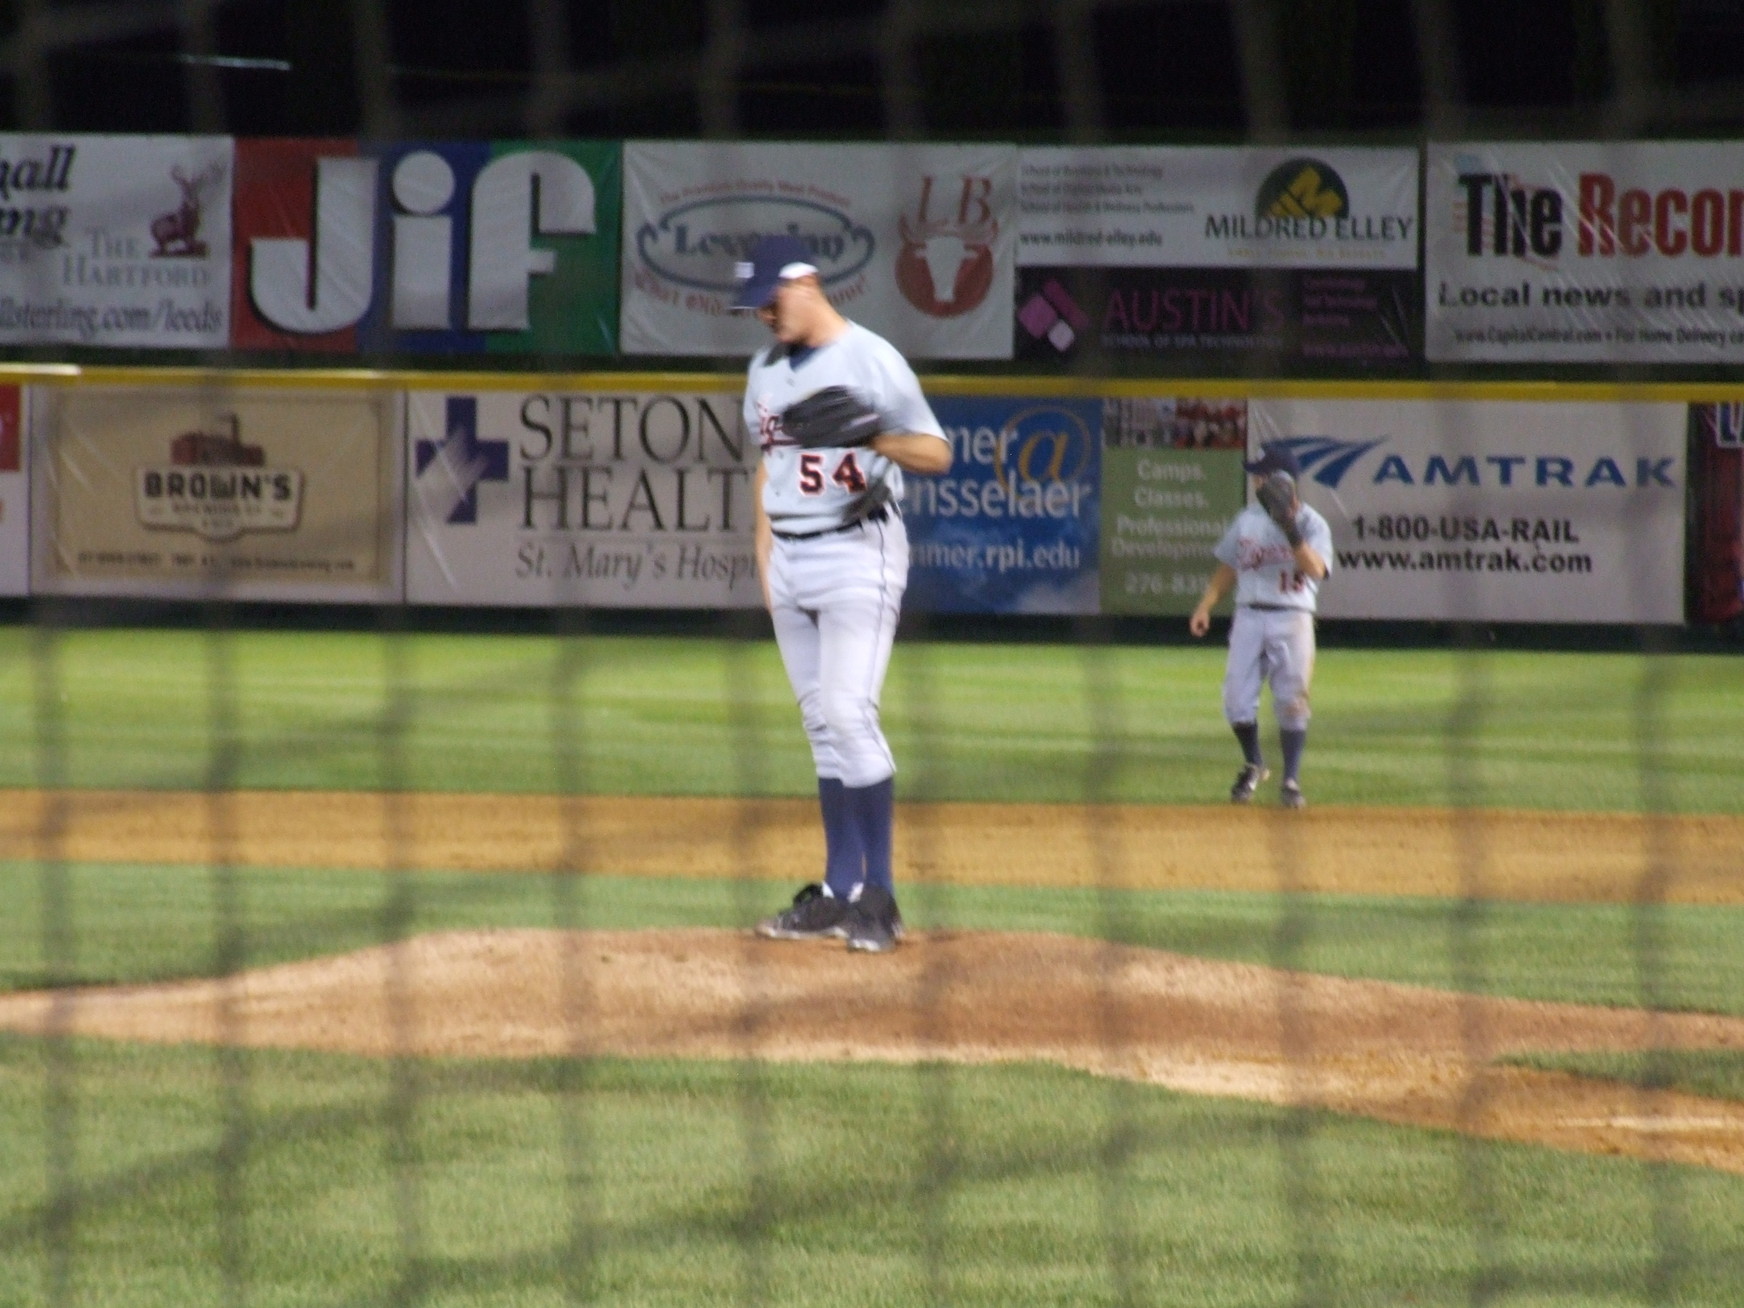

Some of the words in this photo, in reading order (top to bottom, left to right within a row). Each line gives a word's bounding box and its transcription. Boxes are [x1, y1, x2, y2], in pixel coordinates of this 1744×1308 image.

[1205, 213, 1327, 241] MILDRED
[1335, 215, 1414, 241] ELLEY
[1458, 172, 1563, 256] The
[251, 151, 596, 333] Jif
[1439, 281, 1531, 308] Local
[1543, 285, 1631, 308] news
[1646, 282, 1706, 308] and
[520, 394, 747, 463] SETON
[144, 471, 291, 501] BROWN'S
[798, 451, 867, 497] 54
[1373, 454, 1677, 488] AMTRAK
[521, 466, 757, 532] HEALT
[903, 470, 1092, 519] nsselaer
[1351, 514, 1580, 544] 1-800-USA-RAIL
[516, 543, 553, 579] St.
[566, 544, 666, 591] Mary's
[1337, 547, 1593, 574] www.amtrak.com
